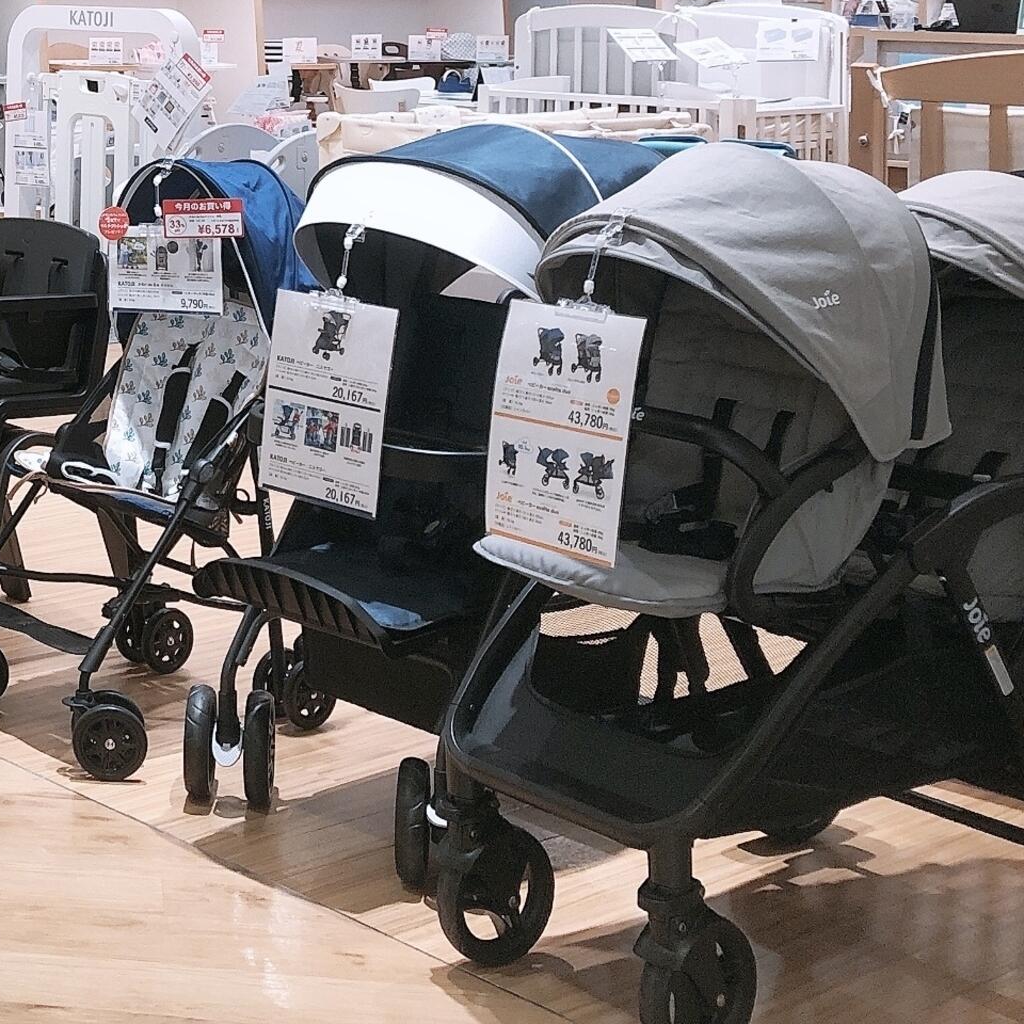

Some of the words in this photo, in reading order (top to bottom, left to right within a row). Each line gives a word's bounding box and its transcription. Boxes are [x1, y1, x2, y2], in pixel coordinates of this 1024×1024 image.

[69, 9, 114, 28] KATOJI
[174, 201, 232, 211] 今月のお買い得
[198, 224, 235, 236] ¥6,578
[812, 289, 841, 311] Joie
[276, 355, 296, 364] KATOJI
[504, 375, 523, 386] Joie
[567, 410, 608, 431] 43,780円
[631, 407, 645, 421] ie
[269, 453, 288, 463] KATOJI
[495, 491, 513, 504] Joie
[557, 530, 598, 554] 43,780円
[962, 596, 991, 645] Joie
